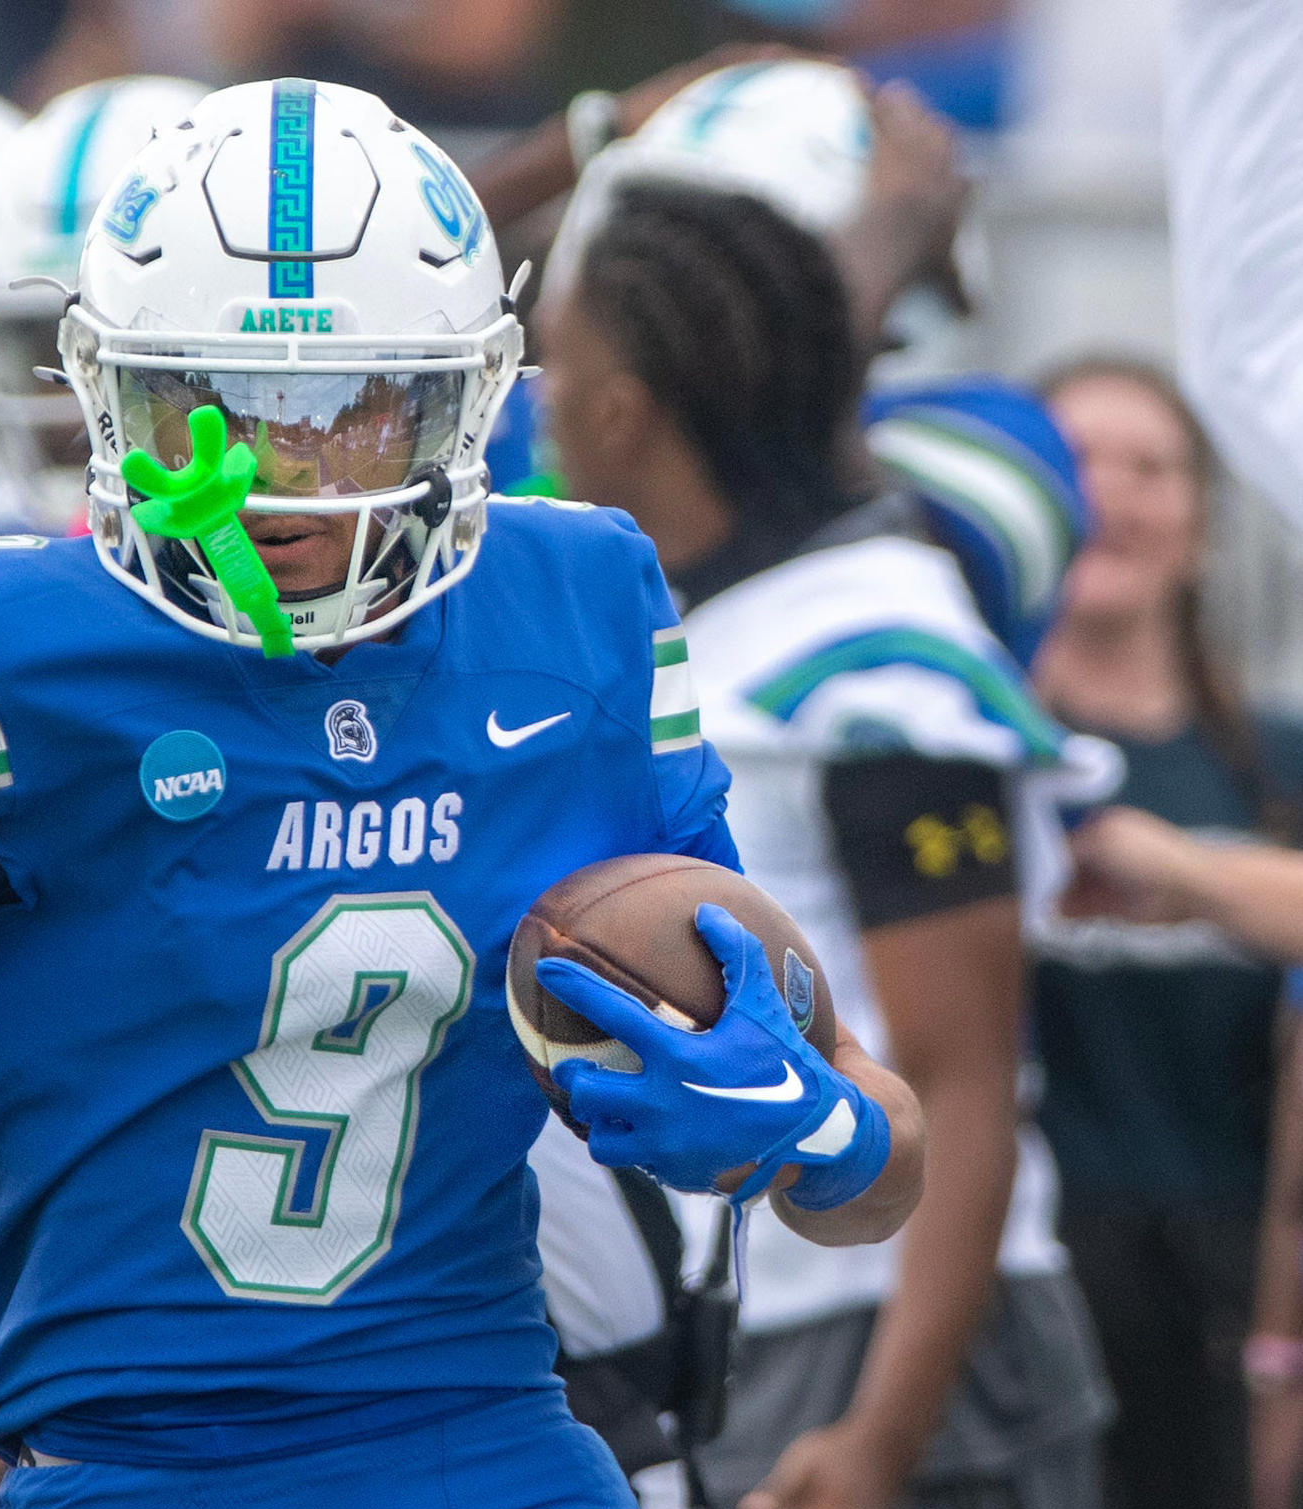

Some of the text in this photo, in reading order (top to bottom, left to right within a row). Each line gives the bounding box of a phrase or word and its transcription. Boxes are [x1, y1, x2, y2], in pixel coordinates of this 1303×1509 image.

[240, 308, 332, 333] ARETE
[154, 768, 223, 802] NCAA
[265, 792, 463, 871] ARGOS
[180, 890, 477, 1305] 9
